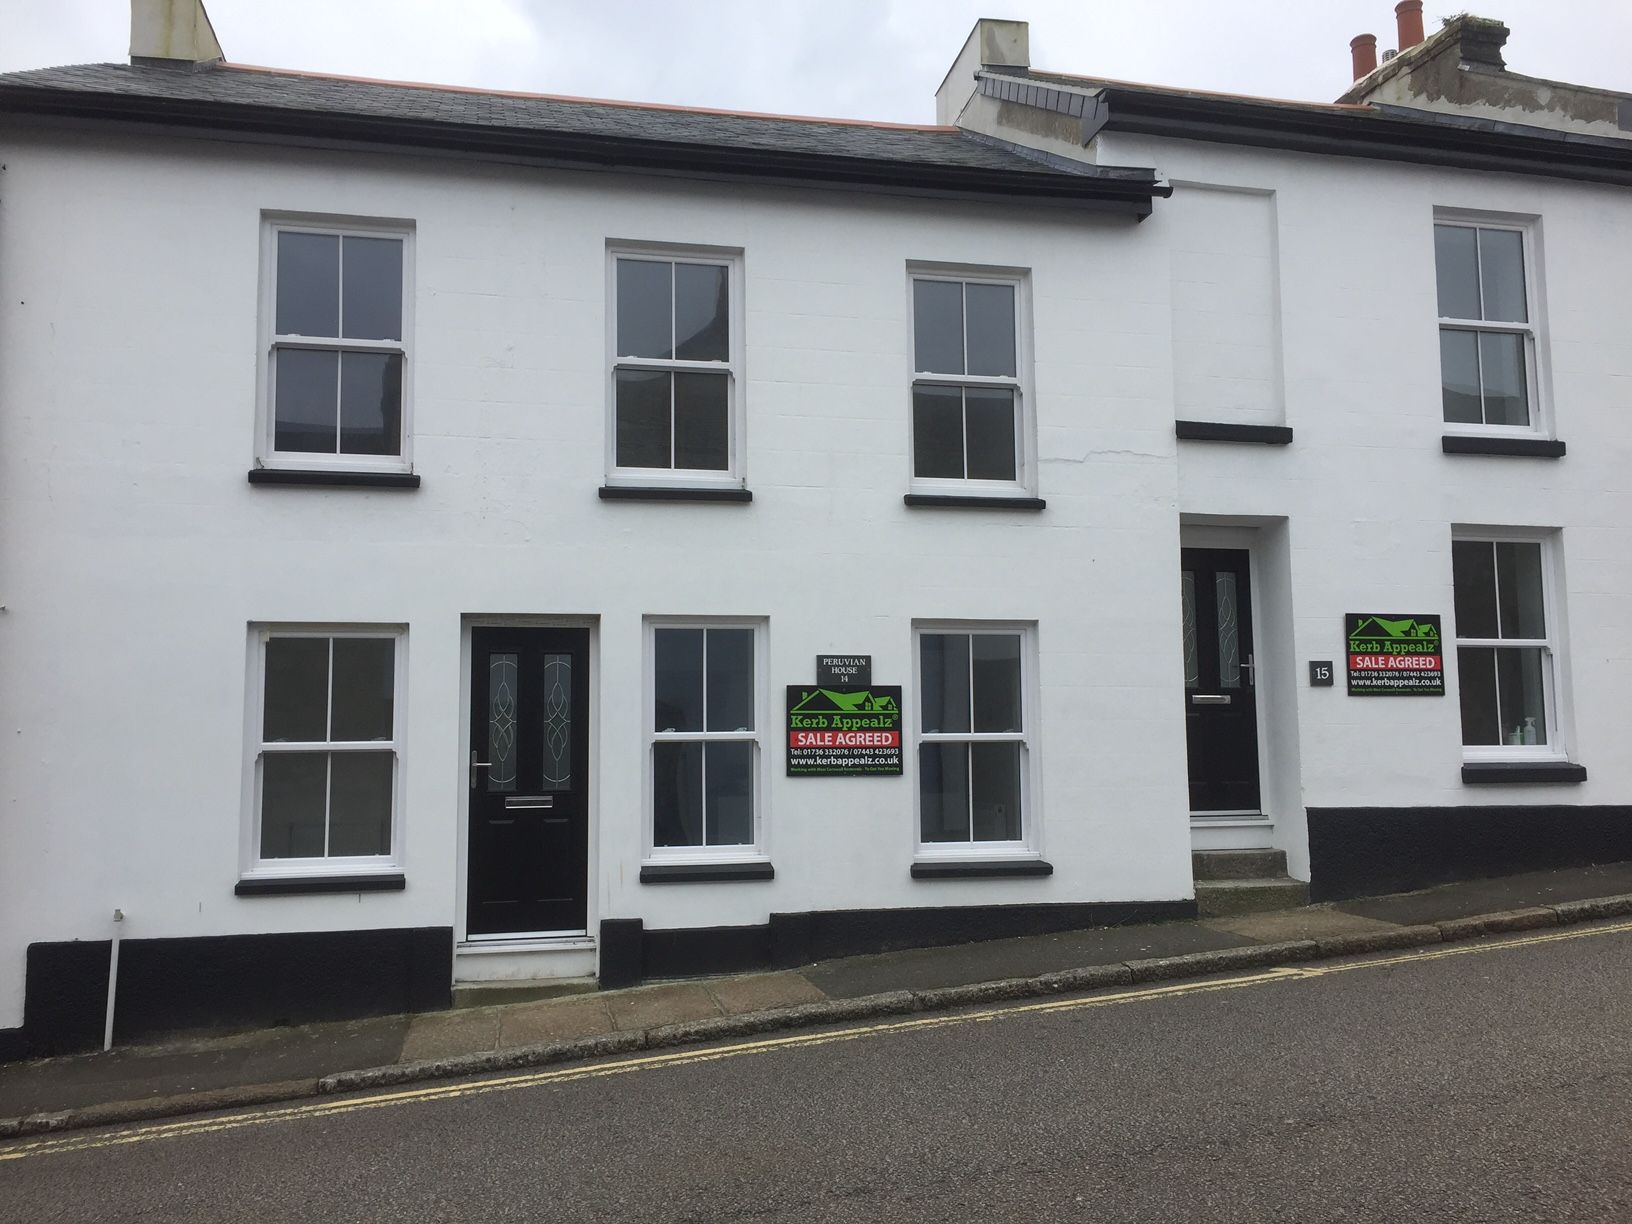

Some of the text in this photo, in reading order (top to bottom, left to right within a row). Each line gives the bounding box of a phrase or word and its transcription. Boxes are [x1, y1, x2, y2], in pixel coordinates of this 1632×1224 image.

[1349, 640, 1435, 655] Kerb Appealz
[823, 658, 866, 666] PERUVIAN
[1356, 656, 1435, 668] SALE AGREED
[831, 666, 858, 674] HOUSE
[1315, 667, 1329, 679] 15
[1351, 678, 1441, 687] www.kerbappealz.co.uk
[790, 715, 893, 730] Kerb Appealz
[798, 733, 893, 745] SALE AGREED
[790, 756, 899, 766] www.kerbappealz.co.uk
